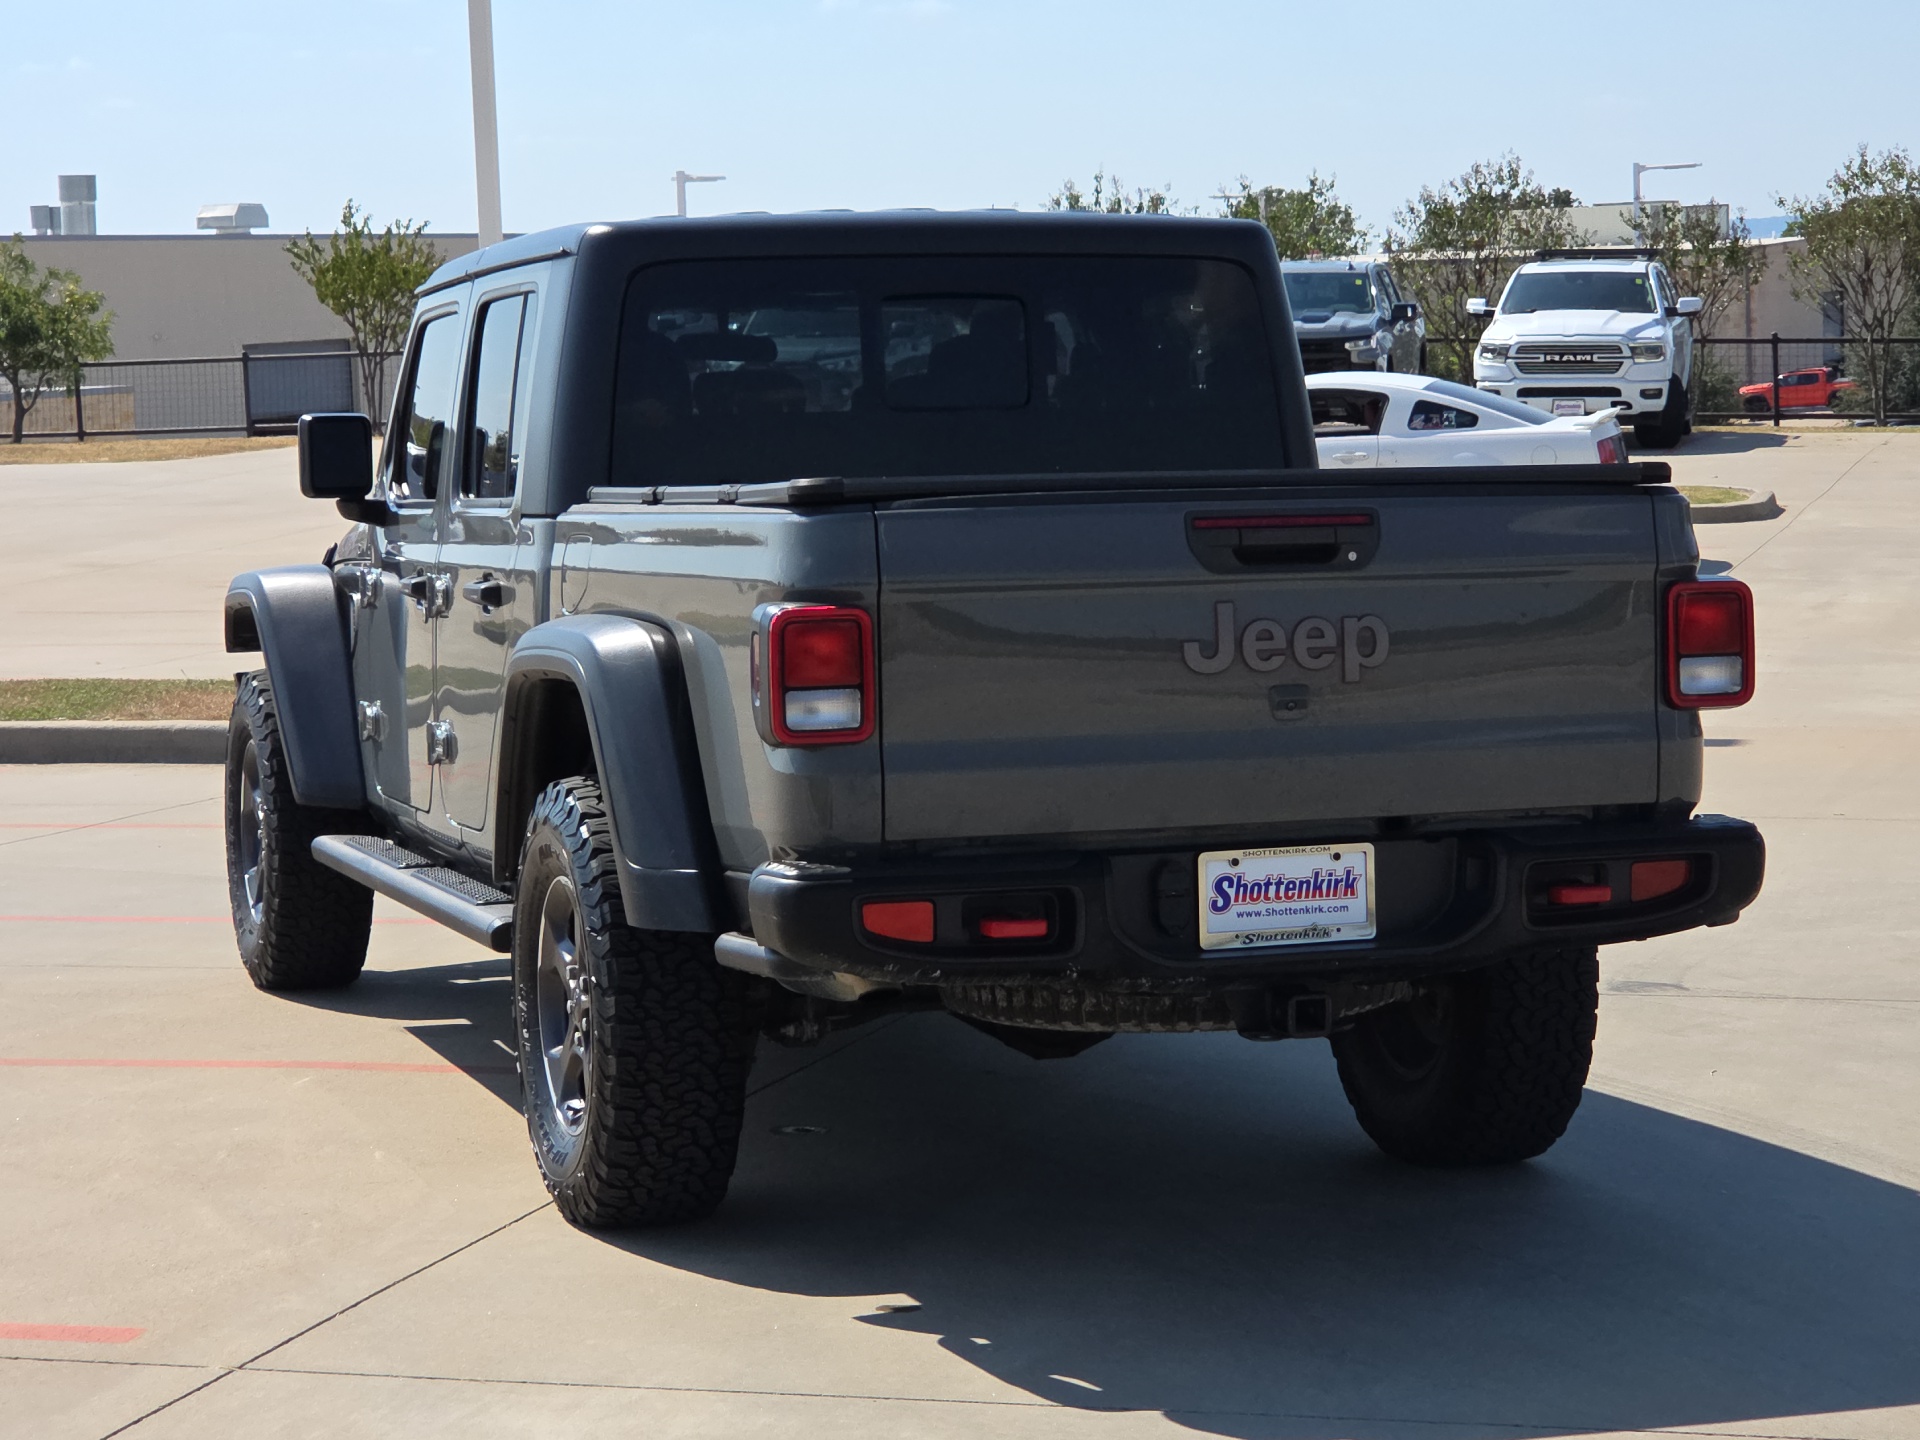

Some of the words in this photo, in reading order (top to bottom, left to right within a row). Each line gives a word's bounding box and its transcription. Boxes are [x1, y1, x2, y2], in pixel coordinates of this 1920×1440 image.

[1181, 600, 1390, 684] Jeep
[1242, 846, 1331, 857] SHOTTENKIRK.COM
[1210, 867, 1361, 914] Shottenkirk
[1236, 904, 1349, 918] www.Shottenkirk.com
[1241, 925, 1331, 945] Shottenkirk
